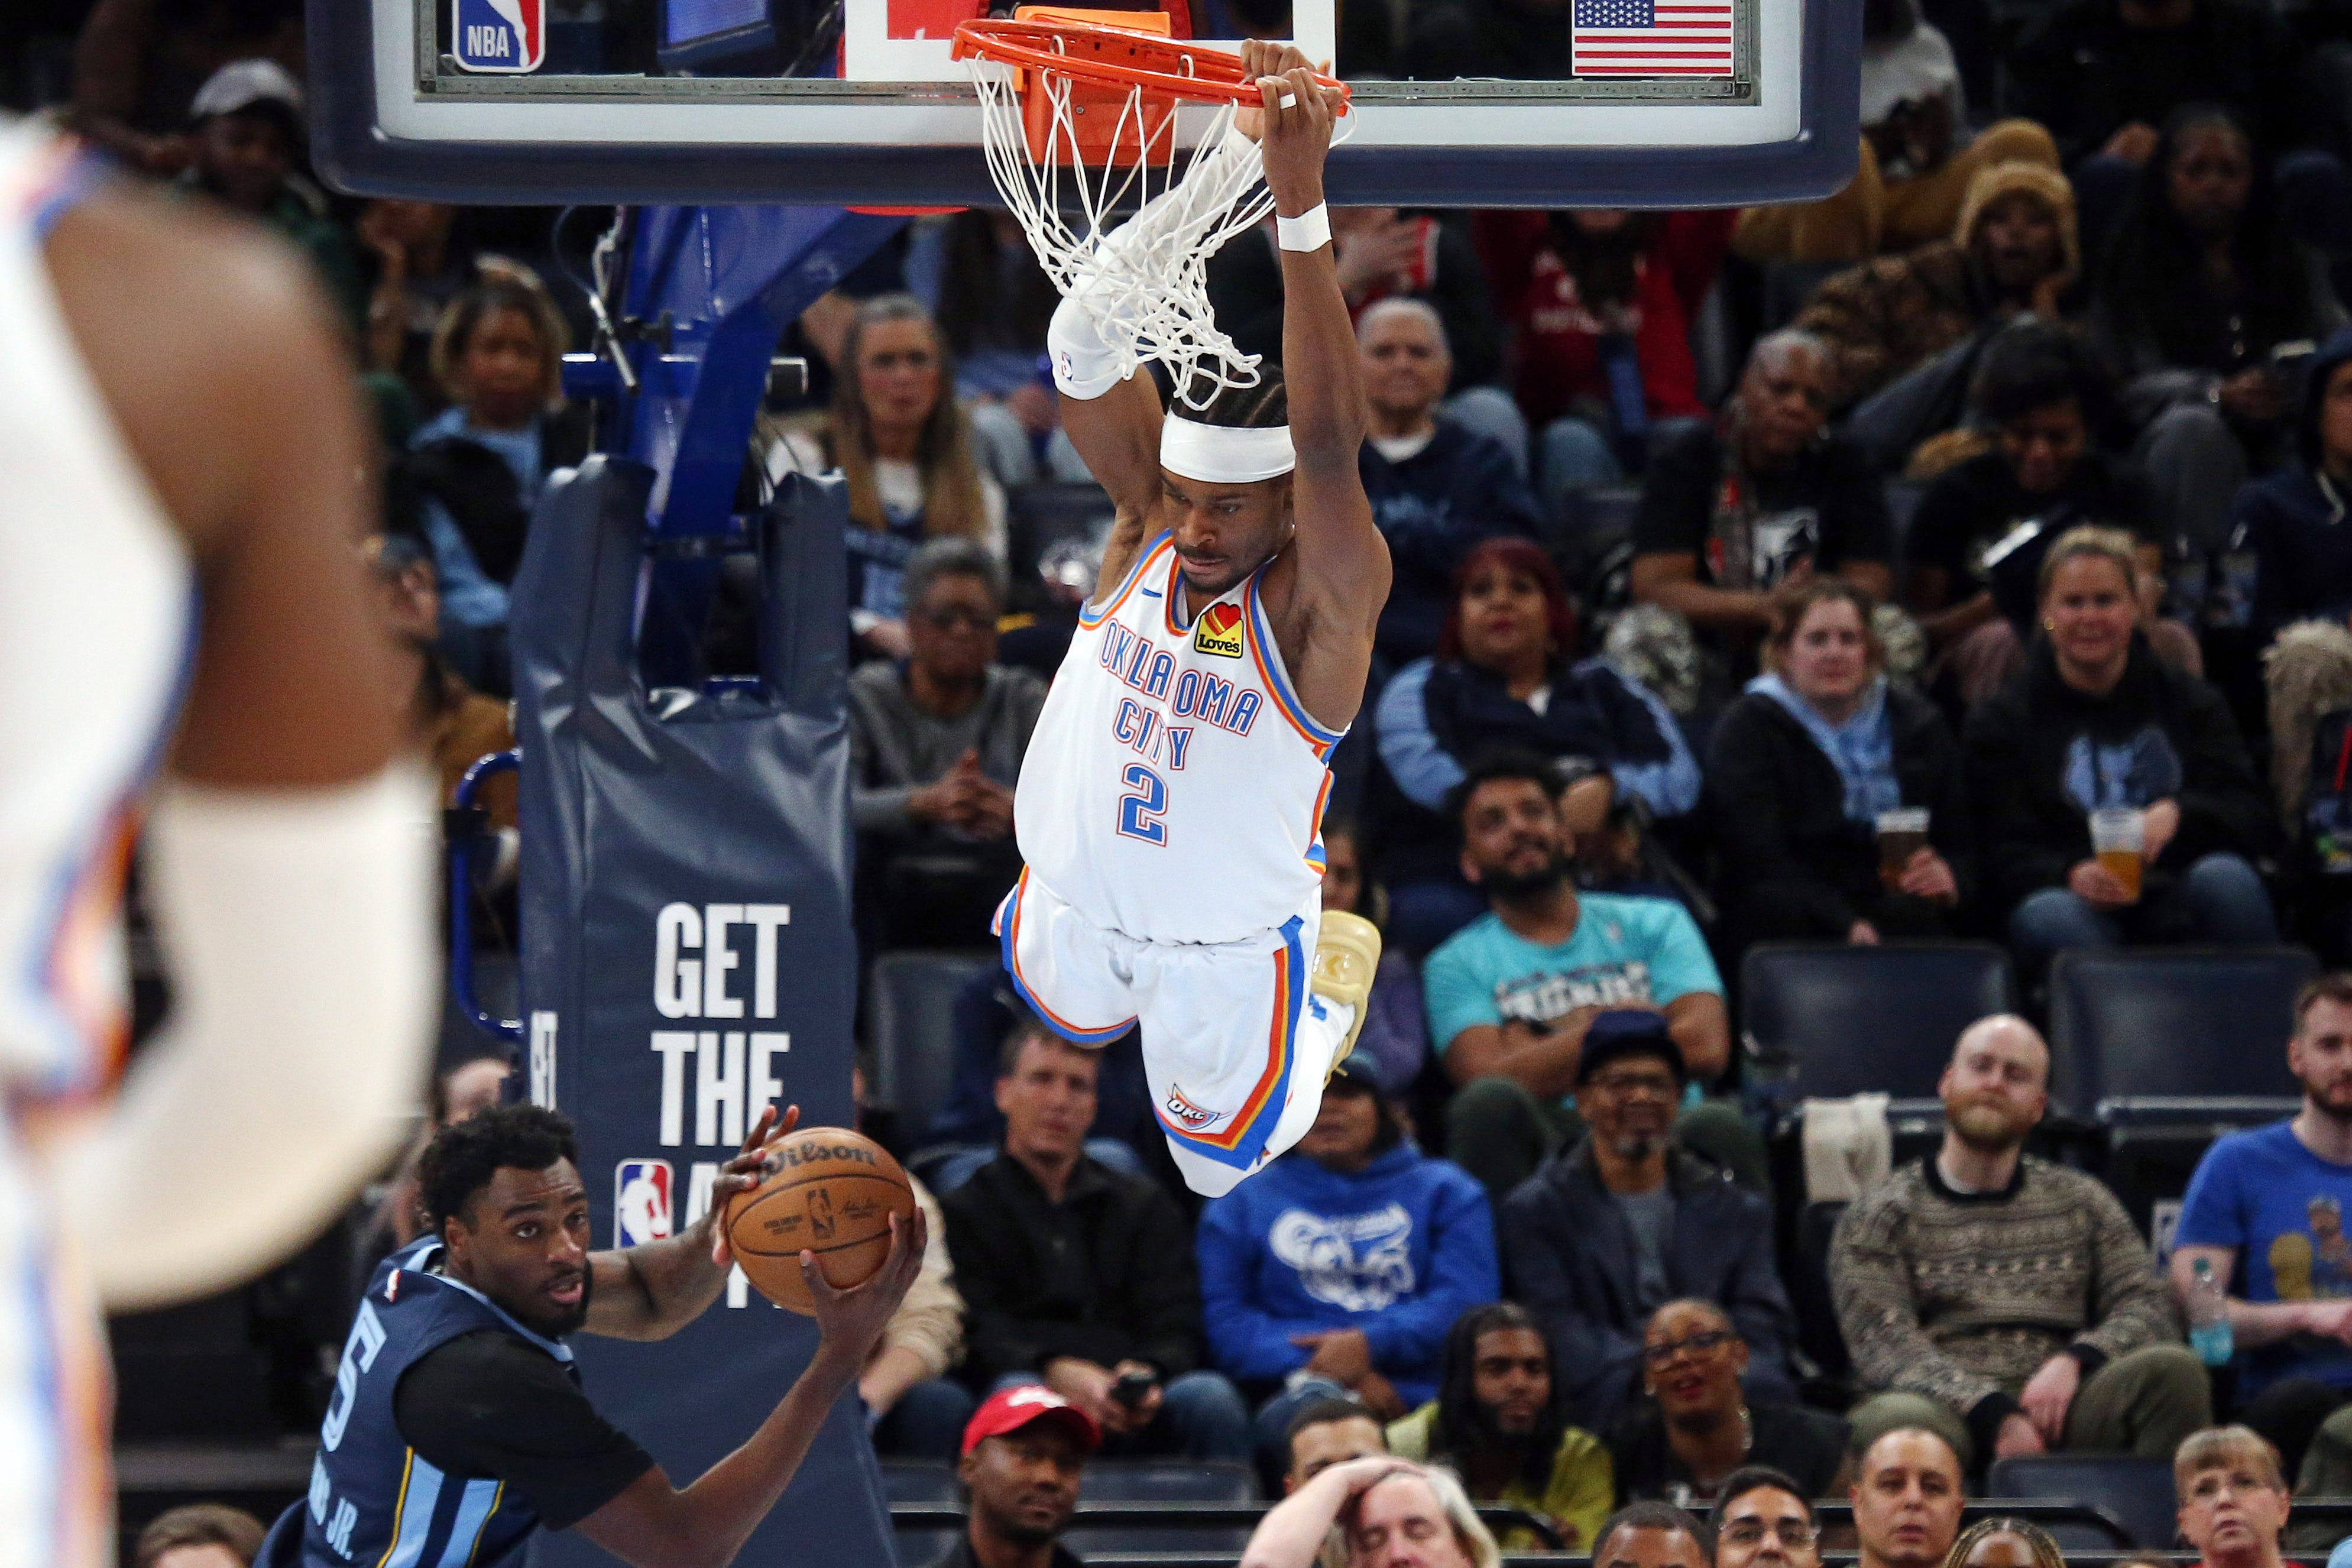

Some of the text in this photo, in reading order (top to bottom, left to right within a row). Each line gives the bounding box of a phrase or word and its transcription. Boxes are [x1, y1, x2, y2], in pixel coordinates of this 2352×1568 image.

[467, 25, 510, 57] NBA
[1099, 618, 1263, 737] OKLAOMA
[1113, 698, 1194, 770] CITY
[1116, 763, 1168, 847] 2
[654, 902, 791, 1019] GET
[651, 1031, 791, 1146] THE
[1167, 1099, 1206, 1120] OKC
[322, 1296, 387, 1452] 5
